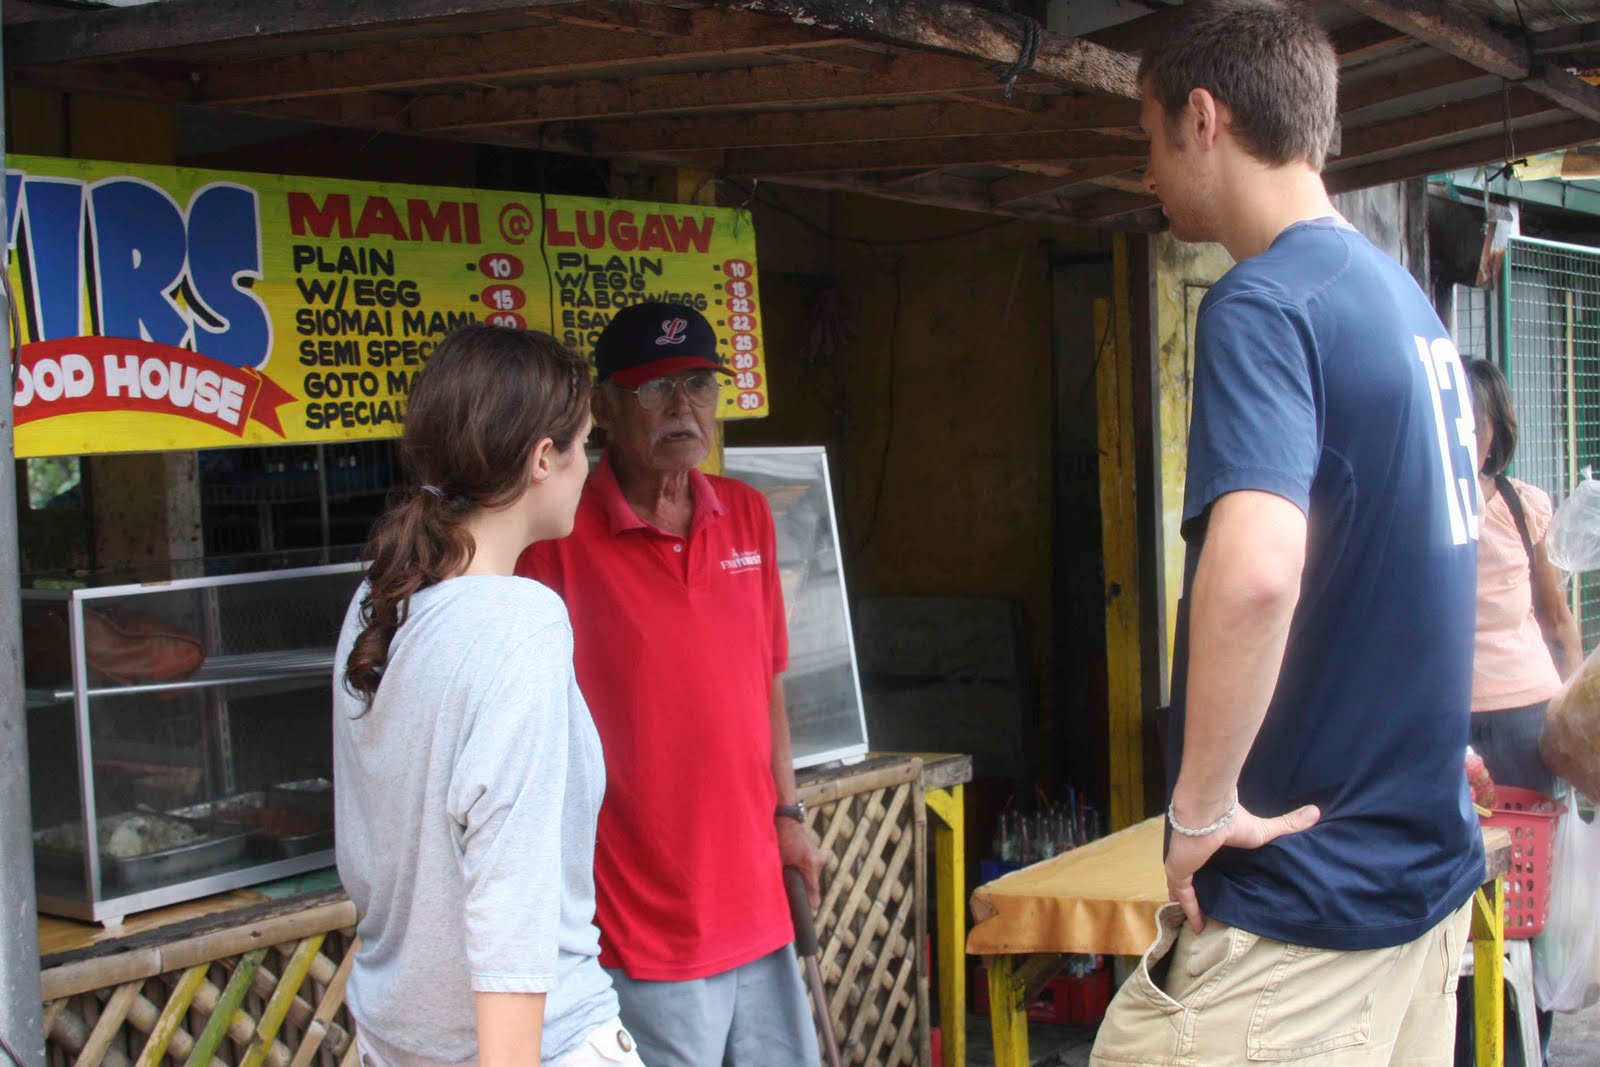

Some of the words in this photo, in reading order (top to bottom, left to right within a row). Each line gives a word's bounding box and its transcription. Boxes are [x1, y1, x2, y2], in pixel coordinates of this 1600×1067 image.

[287, 192, 482, 245] MAMI
[544, 208, 715, 254] LUGAW
[5, 169, 273, 371] IRS
[293, 245, 395, 276] PLAIN
[489, 258, 511, 276] 10
[557, 252, 663, 277] PLAIN
[730, 262, 745, 277] 10
[296, 276, 421, 312] W/EGG
[492, 290, 514, 310] 15
[555, 270, 646, 294] W/EGG
[732, 281, 746, 298] 15
[732, 298, 750, 313] 22
[296, 308, 393, 337] SIOMAI
[402, 309, 476, 337] MAMI
[562, 310, 612, 330] ESA
[732, 315, 751, 331] 22
[655, 318, 687, 345] L
[299, 340, 361, 367] SEMI
[10, 354, 94, 407] OOD
[103, 354, 246, 426] HOUSE
[304, 371, 379, 398] GOTO
[305, 400, 404, 430] SPECIAL
[1414, 335, 1479, 545] 13
